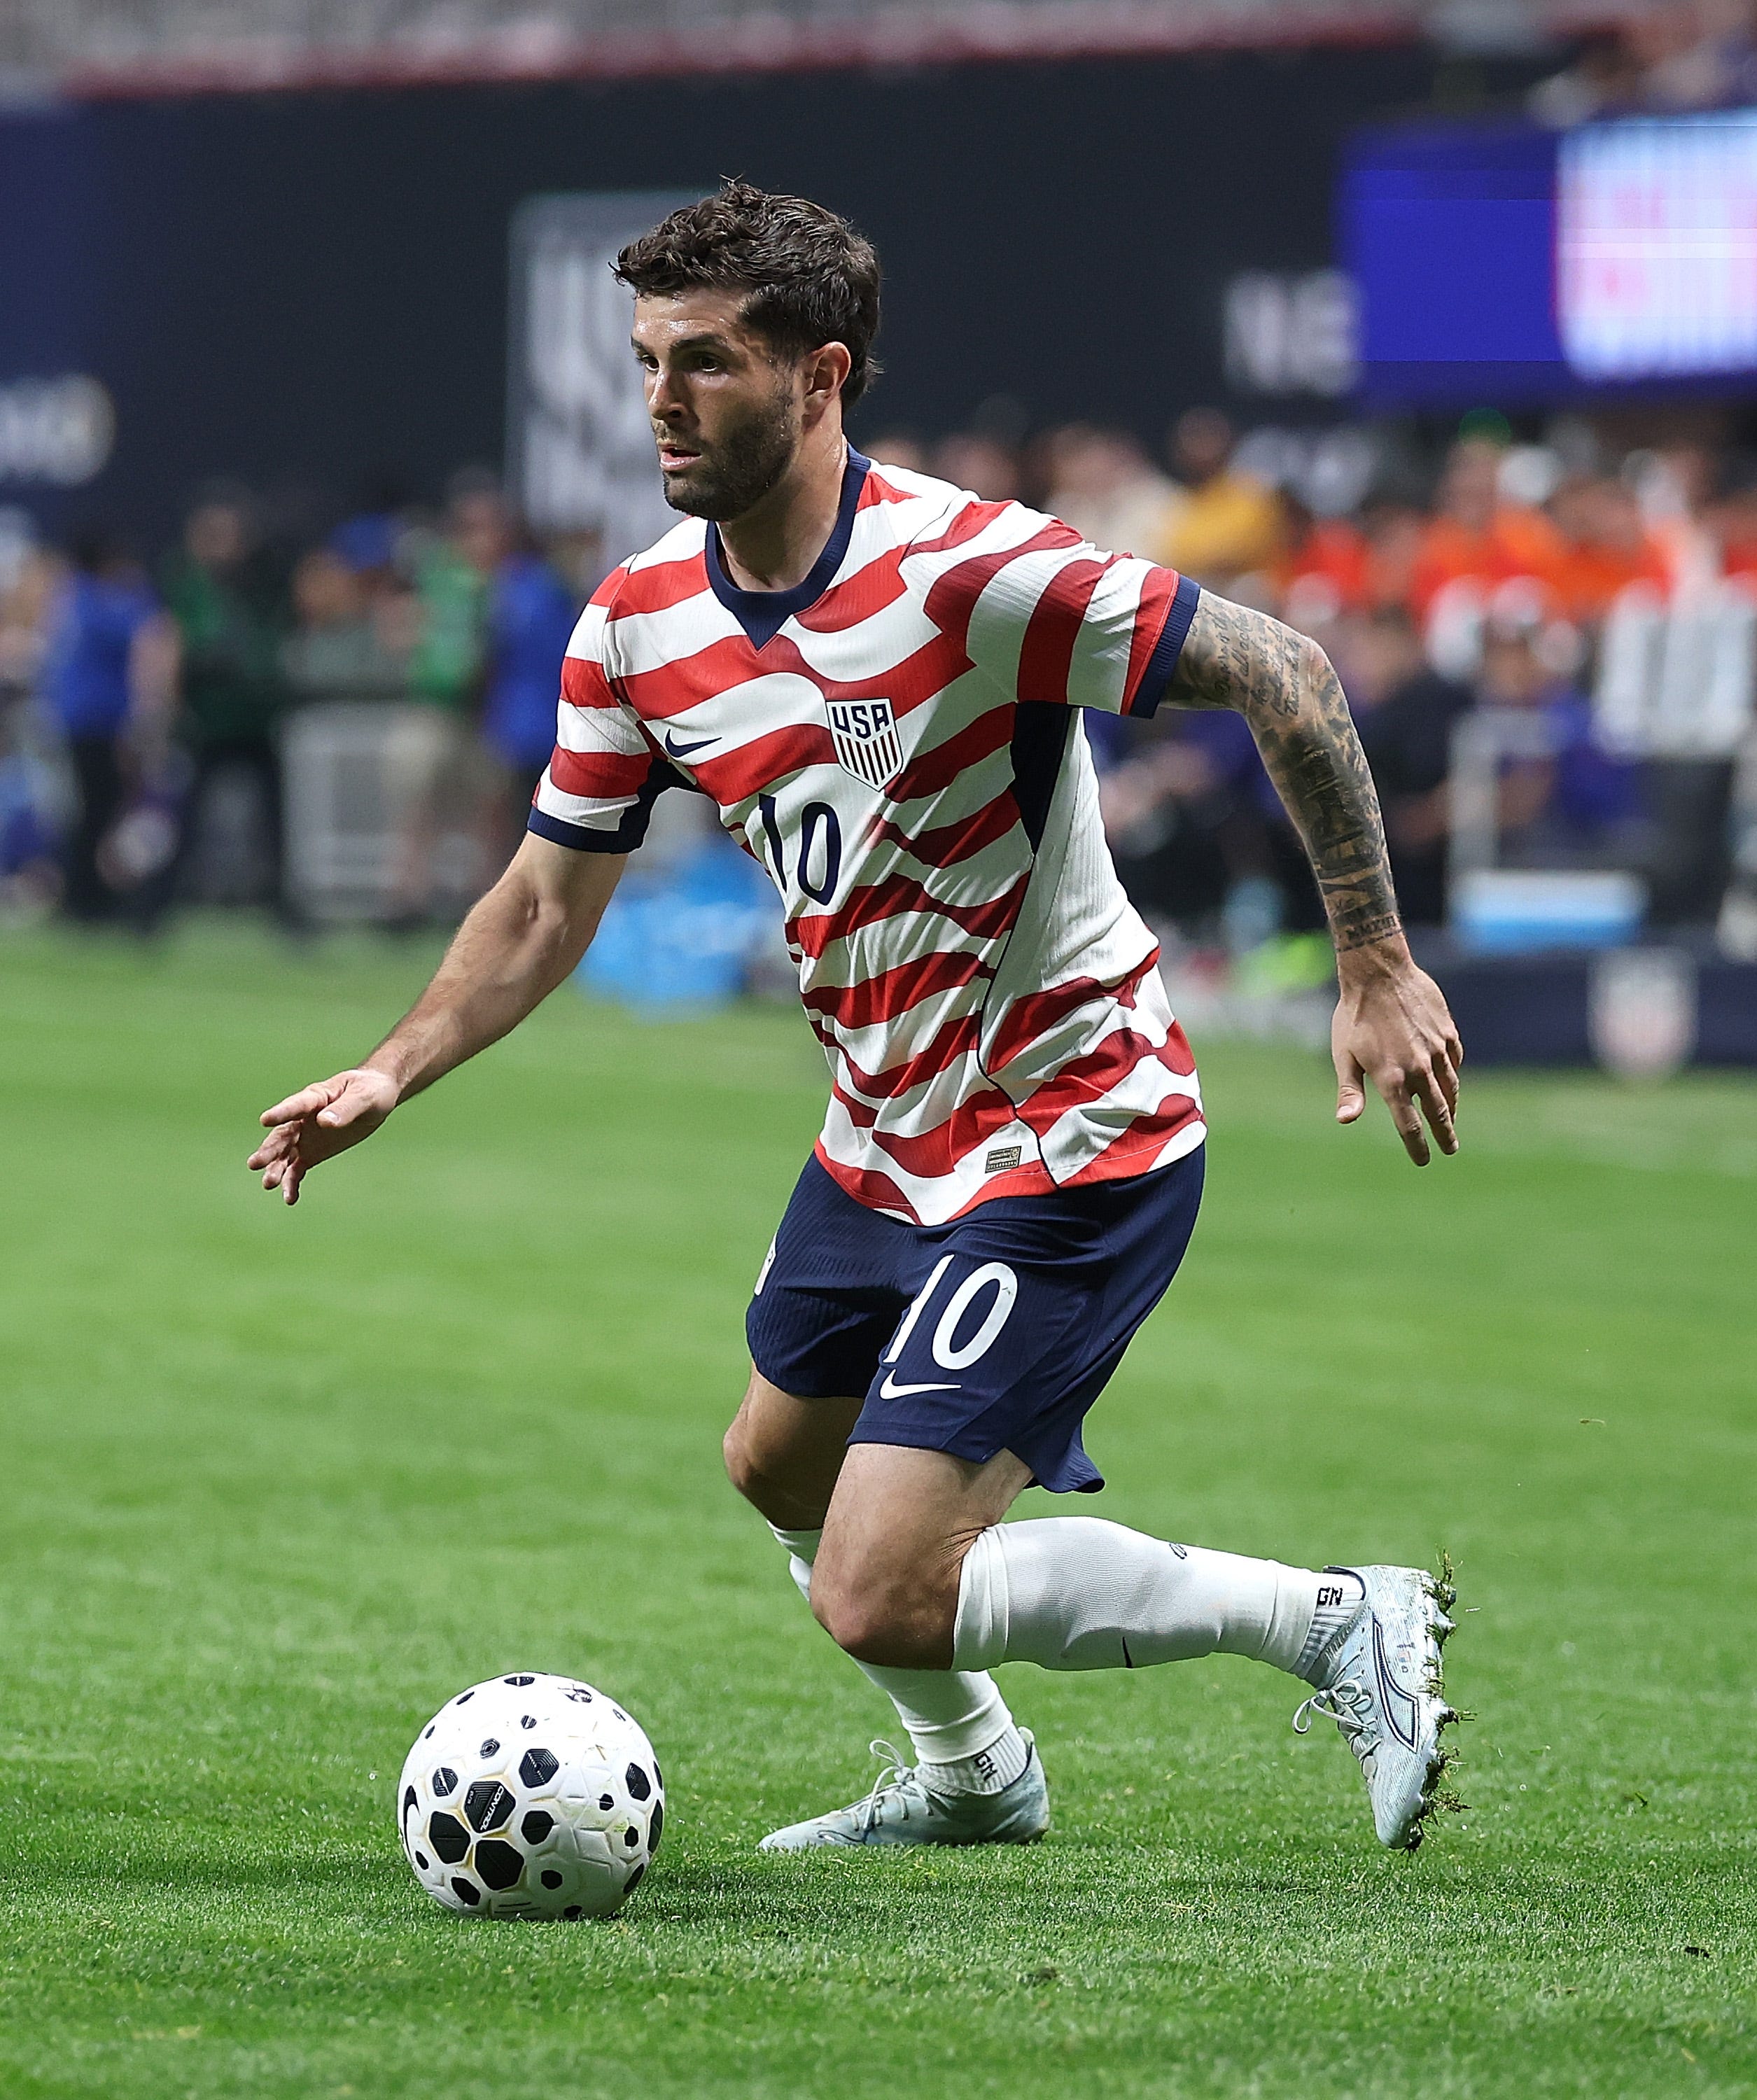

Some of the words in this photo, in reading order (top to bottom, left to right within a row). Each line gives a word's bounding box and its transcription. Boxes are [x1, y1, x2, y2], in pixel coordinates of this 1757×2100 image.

[832, 704, 890, 739] USA
[758, 792, 842, 906] 10
[883, 1254, 1018, 1370] 10
[480, 1785, 504, 1830] CONTROL
